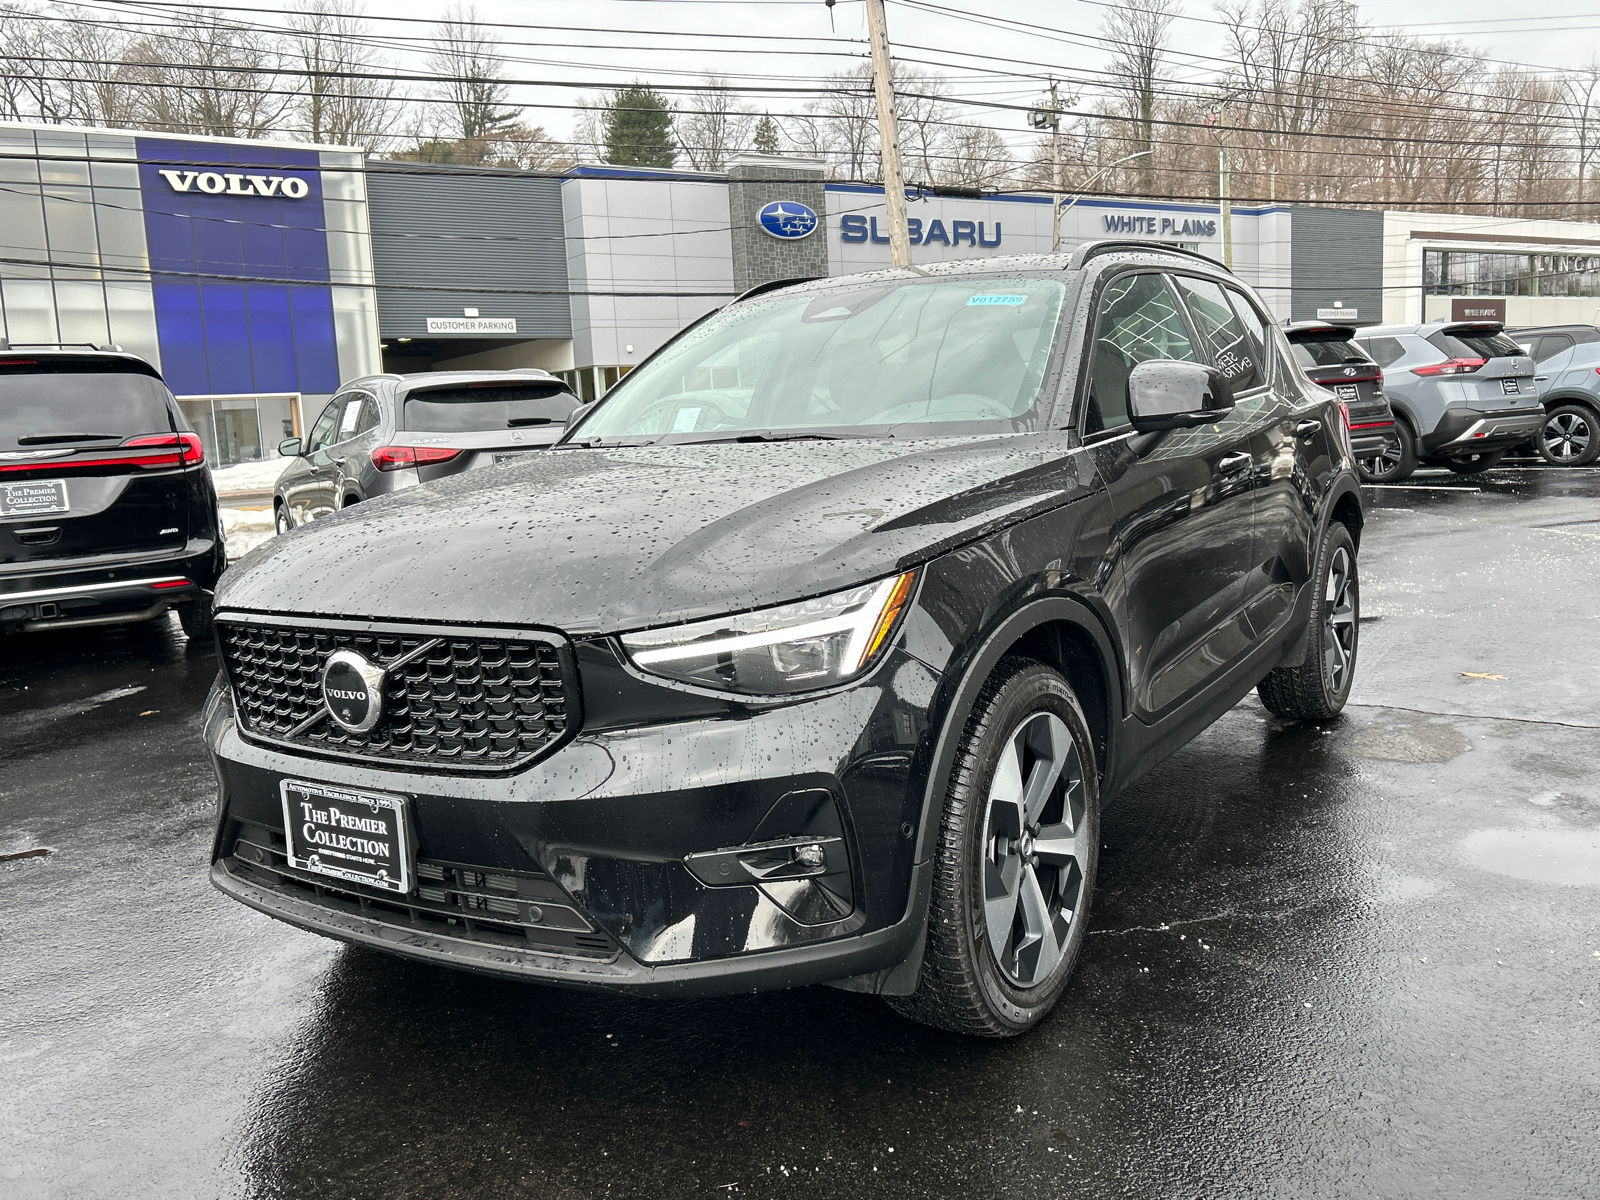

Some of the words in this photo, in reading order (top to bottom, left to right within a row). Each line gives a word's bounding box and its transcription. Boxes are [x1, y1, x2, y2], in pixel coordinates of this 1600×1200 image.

[159, 169, 309, 199] VOLVO
[840, 214, 1002, 248] SUBARU
[1103, 214, 1157, 234] WHITE
[1160, 217, 1217, 237] PLAINS
[430, 321, 476, 330] CUSTOMER
[478, 321, 514, 330] PARKING
[4, 489, 23, 497] THE
[23, 488, 57, 496] PREMIER
[6, 495, 58, 505] COLLECTION
[326, 688, 366, 701] VOLVO
[288, 783, 323, 796] AUTOMOTIVE
[323, 789, 357, 802] EXCELLENCE
[357, 795, 375, 805] SINCE
[300, 801, 329, 825] THE
[328, 807, 388, 836] PREMIER
[302, 822, 390, 858] COLLECTION
[317, 847, 346, 859] EVERYTHING
[345, 853, 363, 862] STARTS
